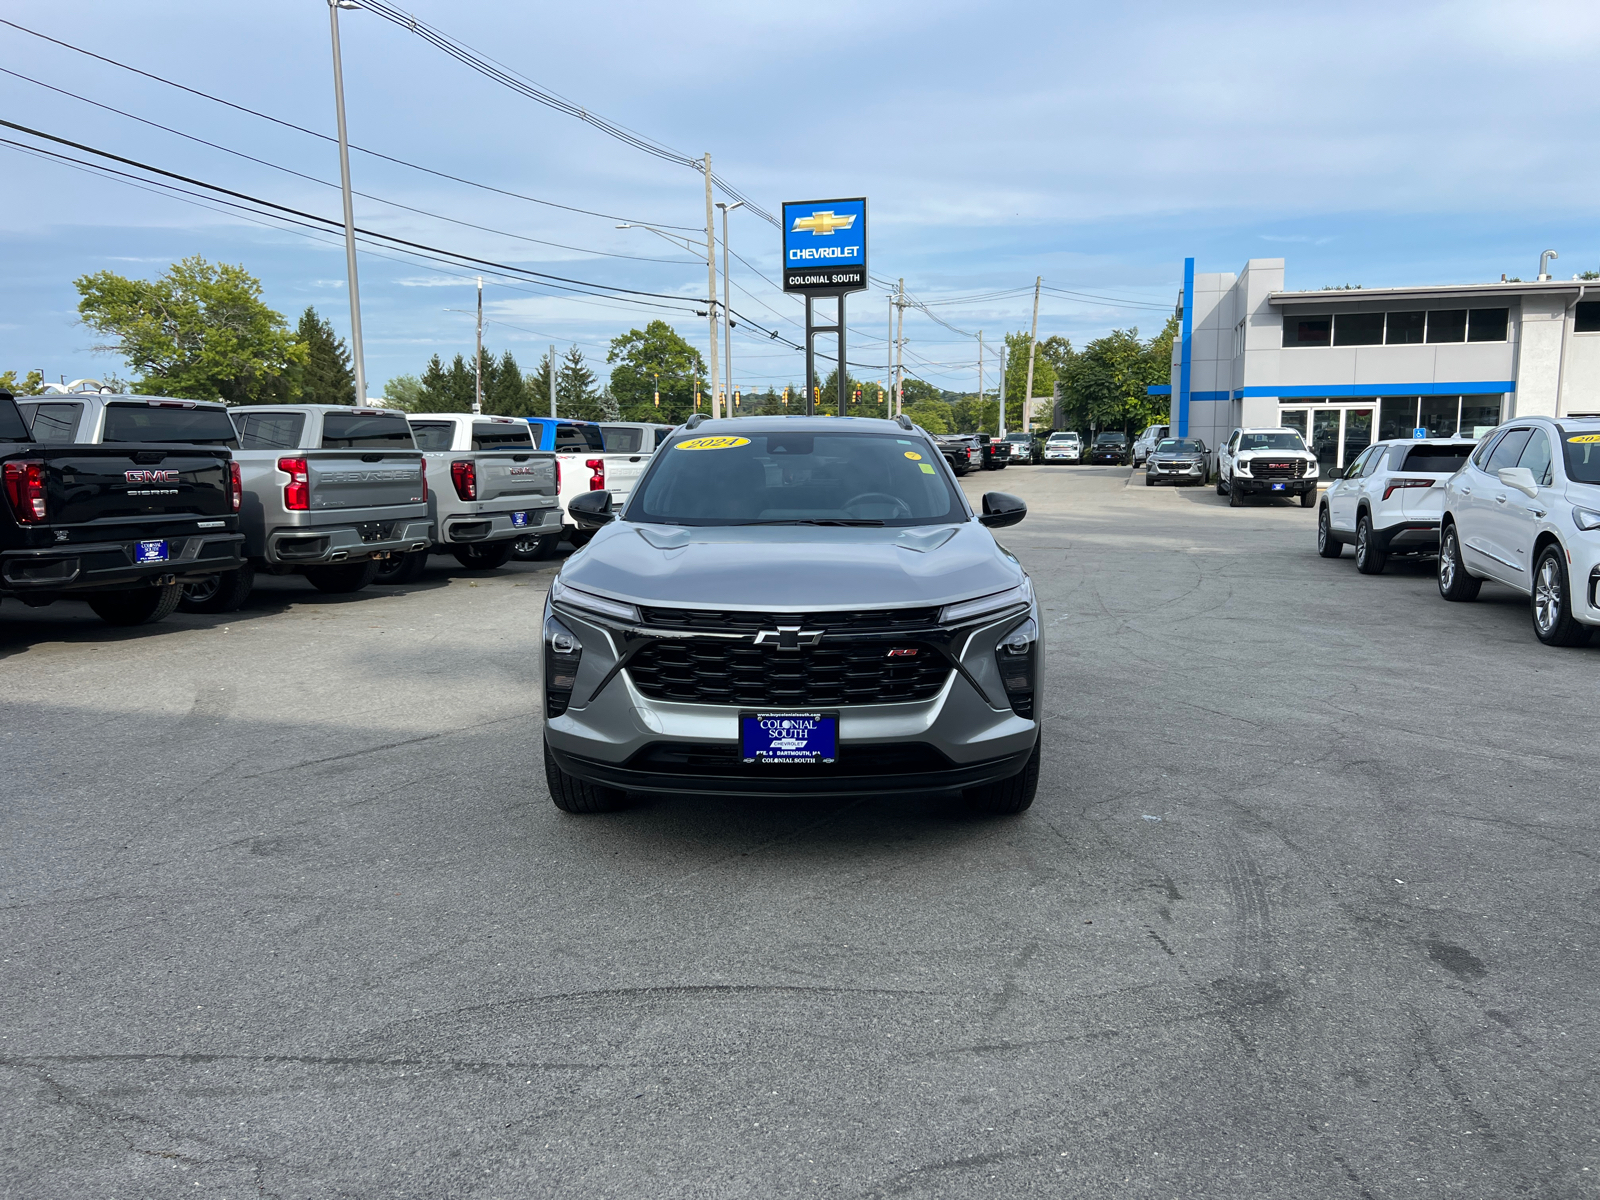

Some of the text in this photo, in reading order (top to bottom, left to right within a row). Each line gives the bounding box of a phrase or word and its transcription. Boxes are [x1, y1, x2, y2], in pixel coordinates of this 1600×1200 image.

[789, 246, 859, 260] CHEVROLET
[789, 273, 860, 285] COLONIAL SOUTH
[686, 438, 740, 449] 2024
[124, 470, 180, 482] GMC
[320, 470, 419, 483] CHEVROLET
[887, 649, 918, 657] RS
[760, 720, 817, 729] COLONIAL
[769, 729, 808, 738] SOUTH
